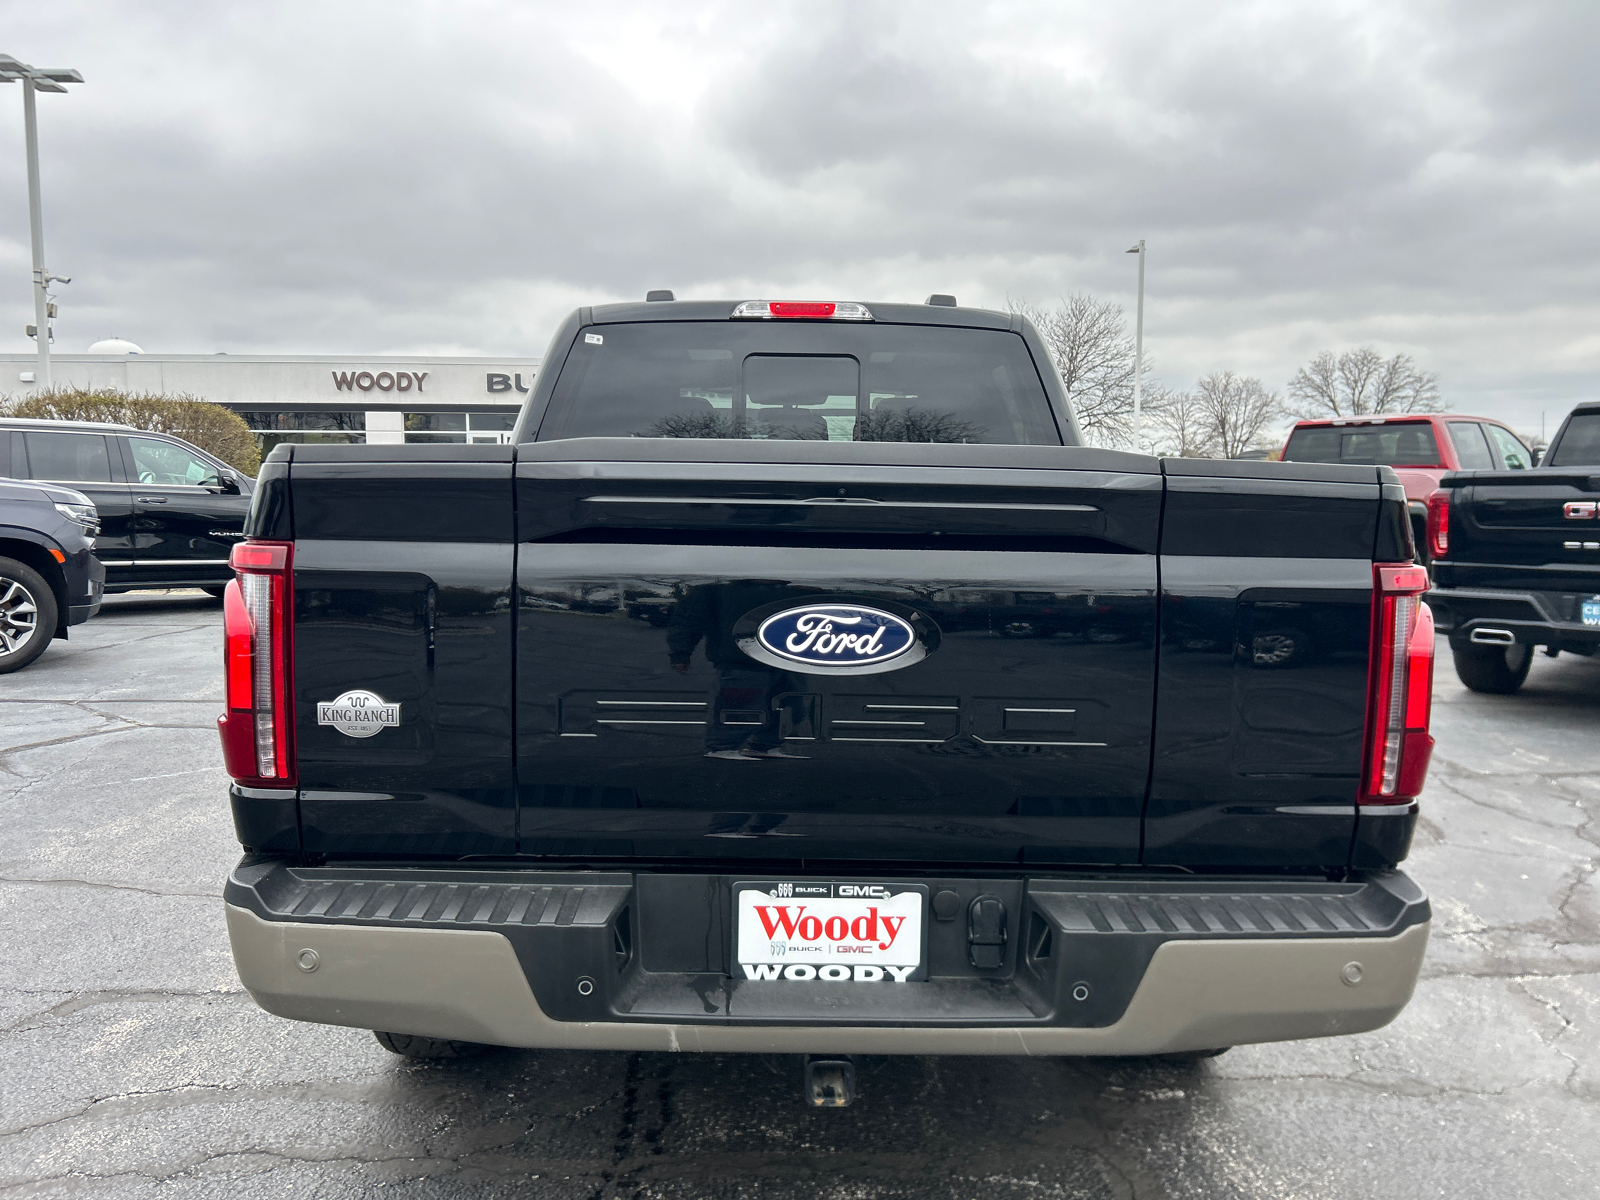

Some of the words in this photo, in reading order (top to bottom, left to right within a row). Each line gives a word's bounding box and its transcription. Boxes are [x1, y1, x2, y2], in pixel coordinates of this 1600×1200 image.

[332, 371, 428, 392] WOODY
[1563, 501, 1600, 519] G
[786, 613, 886, 655] Ford
[322, 707, 351, 722] KING
[355, 708, 394, 722] RANCH
[838, 885, 885, 896] GMC
[753, 905, 907, 951] Woody
[836, 945, 873, 954] GMC
[742, 964, 916, 982] WOODY
